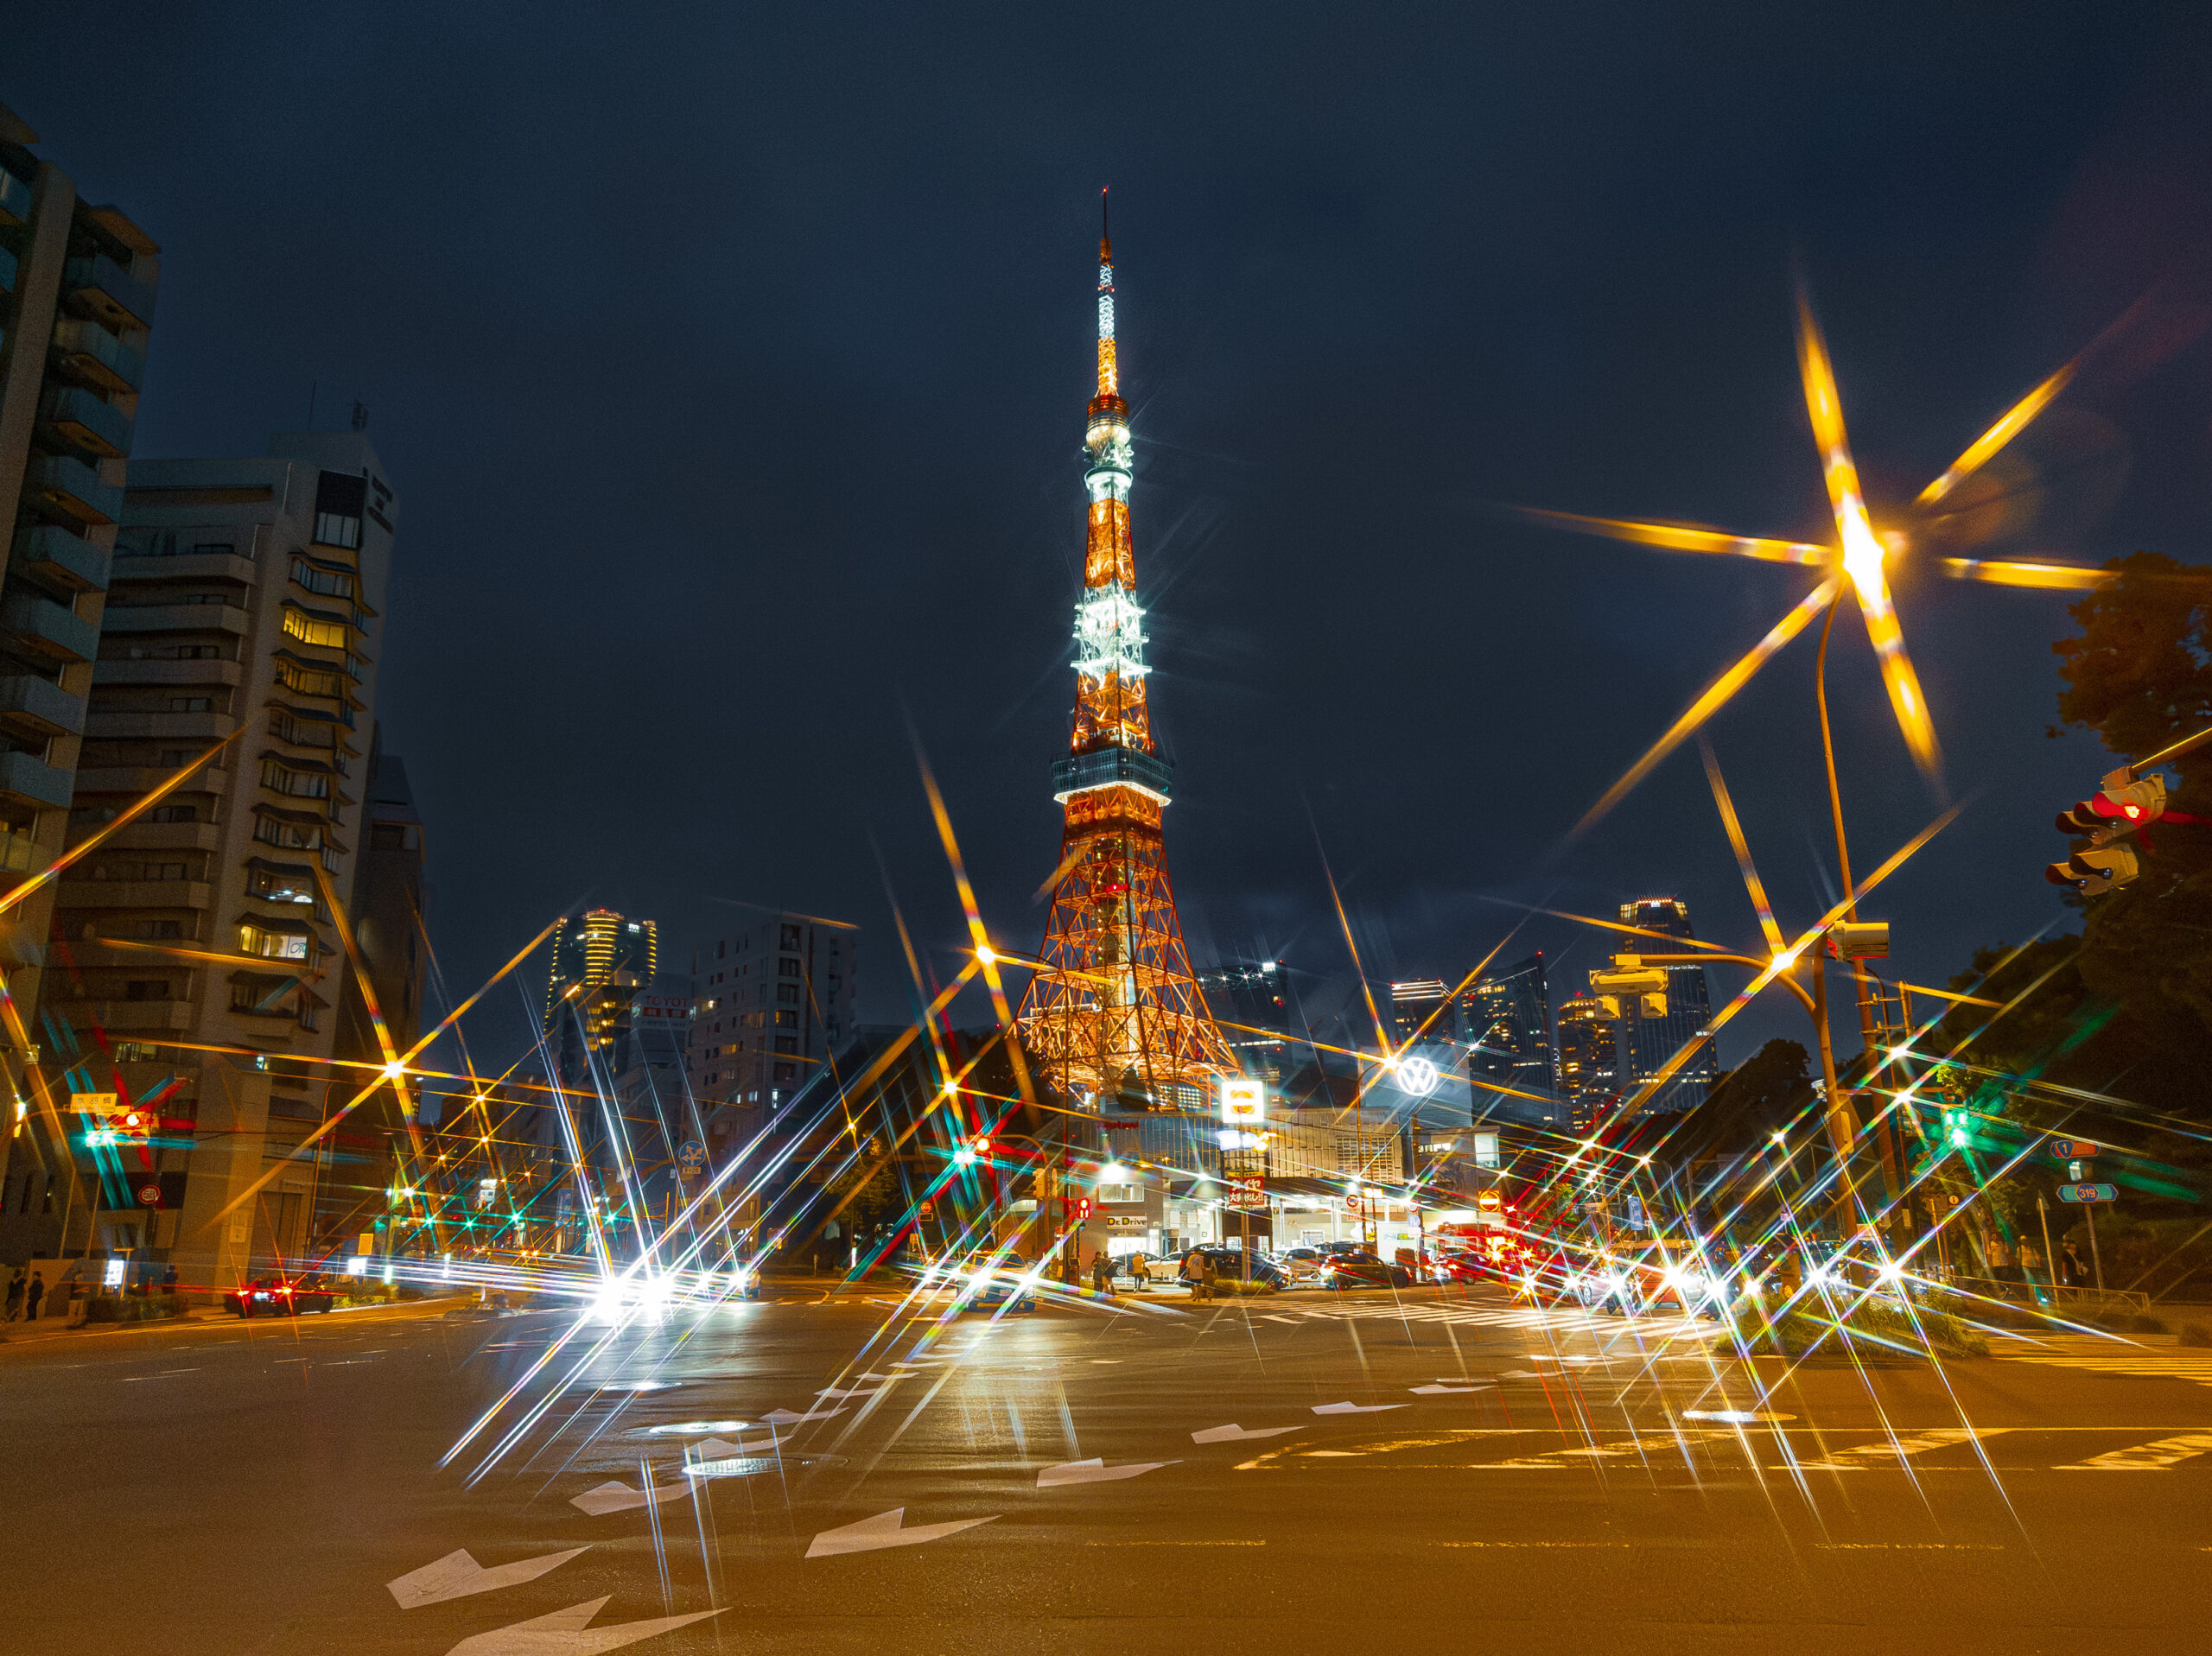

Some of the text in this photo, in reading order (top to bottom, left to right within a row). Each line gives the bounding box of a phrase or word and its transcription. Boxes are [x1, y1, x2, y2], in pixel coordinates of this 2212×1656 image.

[645, 995, 688, 1007] TOYOT
[2062, 1143, 2068, 1154] 1
[2079, 1188, 2096, 1198] 319
